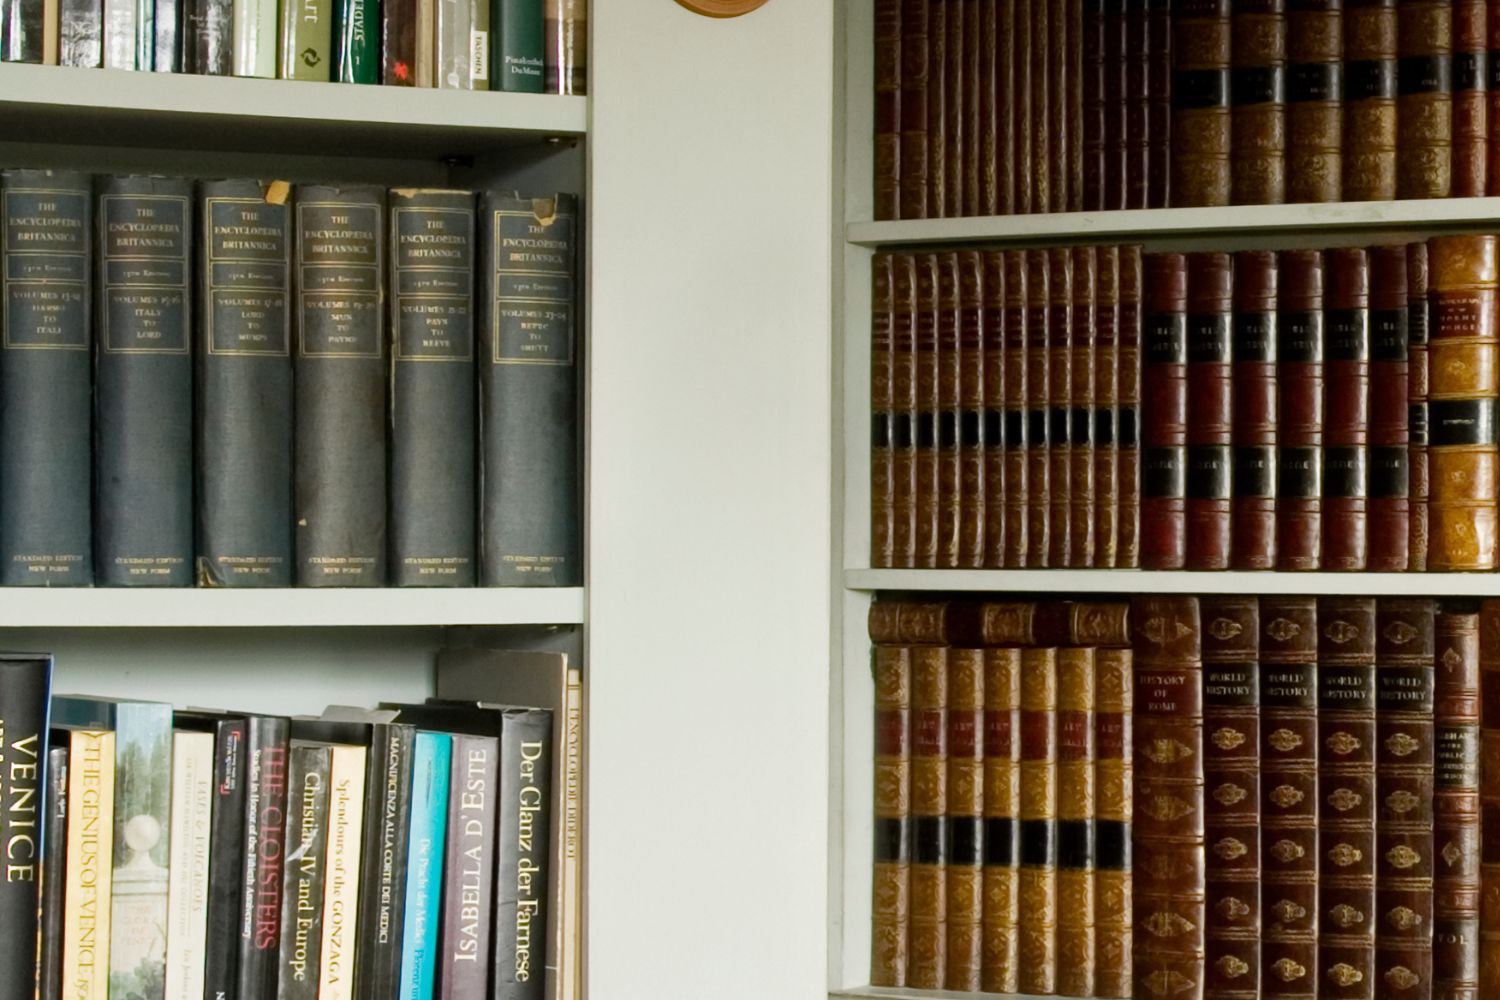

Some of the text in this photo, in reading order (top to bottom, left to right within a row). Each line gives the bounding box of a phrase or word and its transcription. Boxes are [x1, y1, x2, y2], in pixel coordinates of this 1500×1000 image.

[475, 36, 484, 75] TASCHEN
[1206, 686, 1250, 696] HISTORY
[1380, 690, 1426, 701] HISTORY
[83, 743, 102, 787] THE
[384, 735, 400, 818] MAGNIFICENZA
[6, 733, 39, 883] VENICE
[80, 789, 100, 868] GENIUS
[334, 778, 351, 857] Splendours
[255, 746, 285, 950] THE CLOISTERS
[383, 820, 395, 848] ALLA
[79, 868, 98, 892] OF
[300, 855, 317, 876] IV
[381, 849, 394, 884] CORTE
[514, 740, 543, 983] Der Glanz der Farnese
[298, 879, 314, 911] and
[332, 876, 346, 898] the
[453, 846, 483, 962] ISABELLA
[78, 899, 97, 975] VENICE
[328, 900, 344, 985] GONZAGA
[378, 906, 391, 944] MEDICI
[289, 917, 313, 981] Europe
